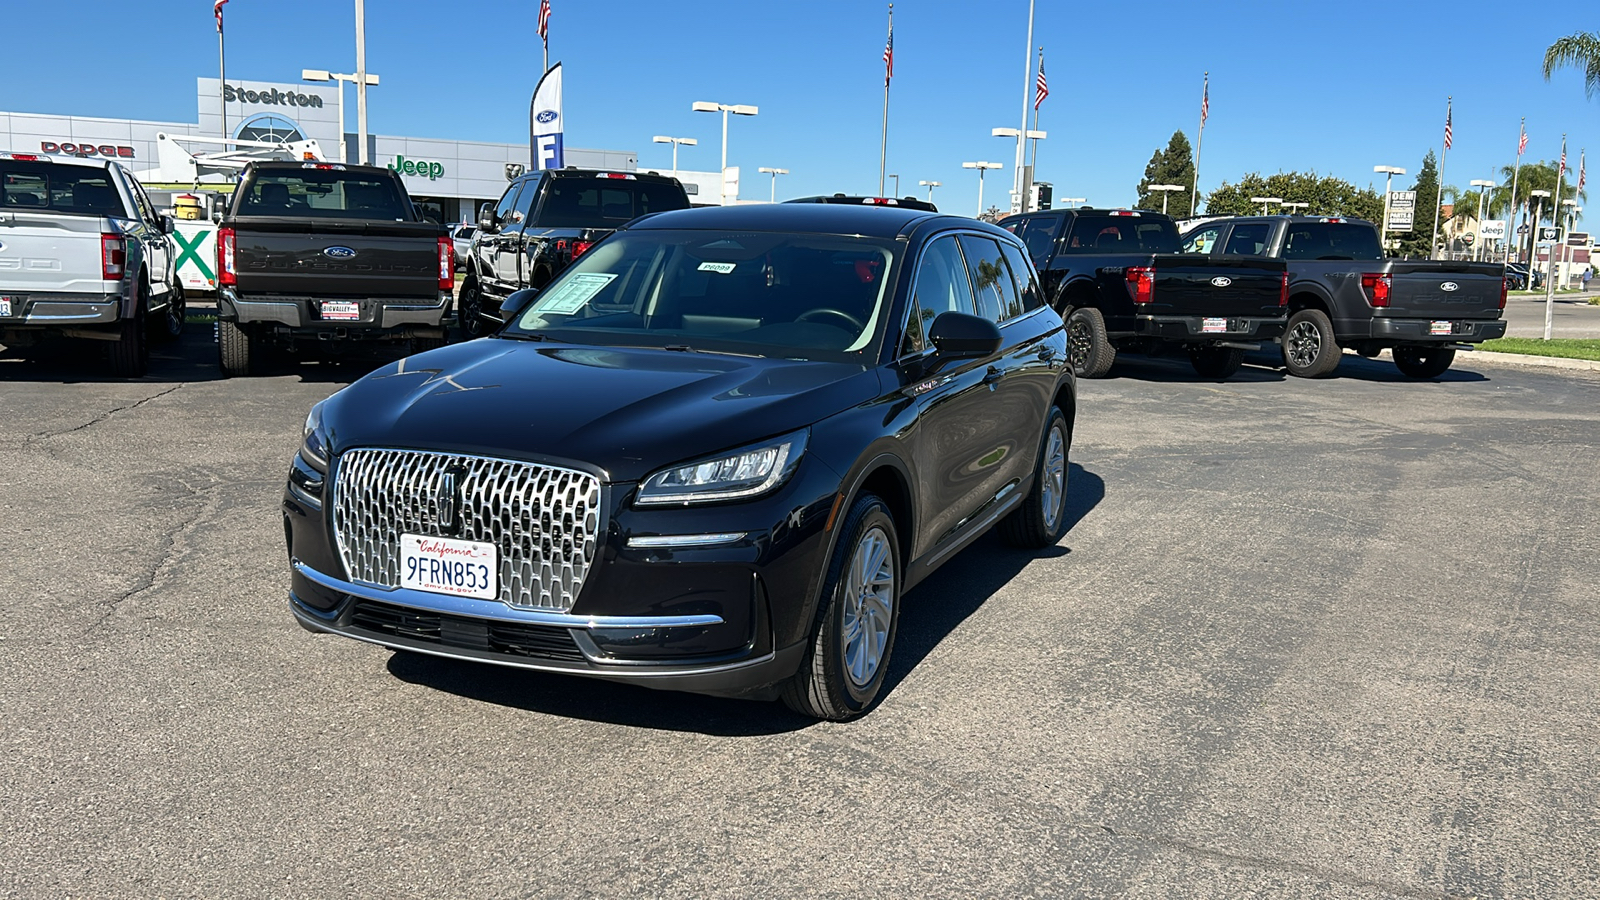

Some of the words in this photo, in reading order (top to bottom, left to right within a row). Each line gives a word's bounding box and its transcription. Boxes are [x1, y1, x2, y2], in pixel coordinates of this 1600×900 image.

[220, 84, 323, 108] Stockton
[41, 141, 135, 158] DODGE
[387, 154, 444, 181] Jeep
[1391, 192, 1414, 200] OEM
[1481, 226, 1503, 235] Jeep
[420, 540, 478, 557] California
[407, 556, 488, 589] 9FRN853
